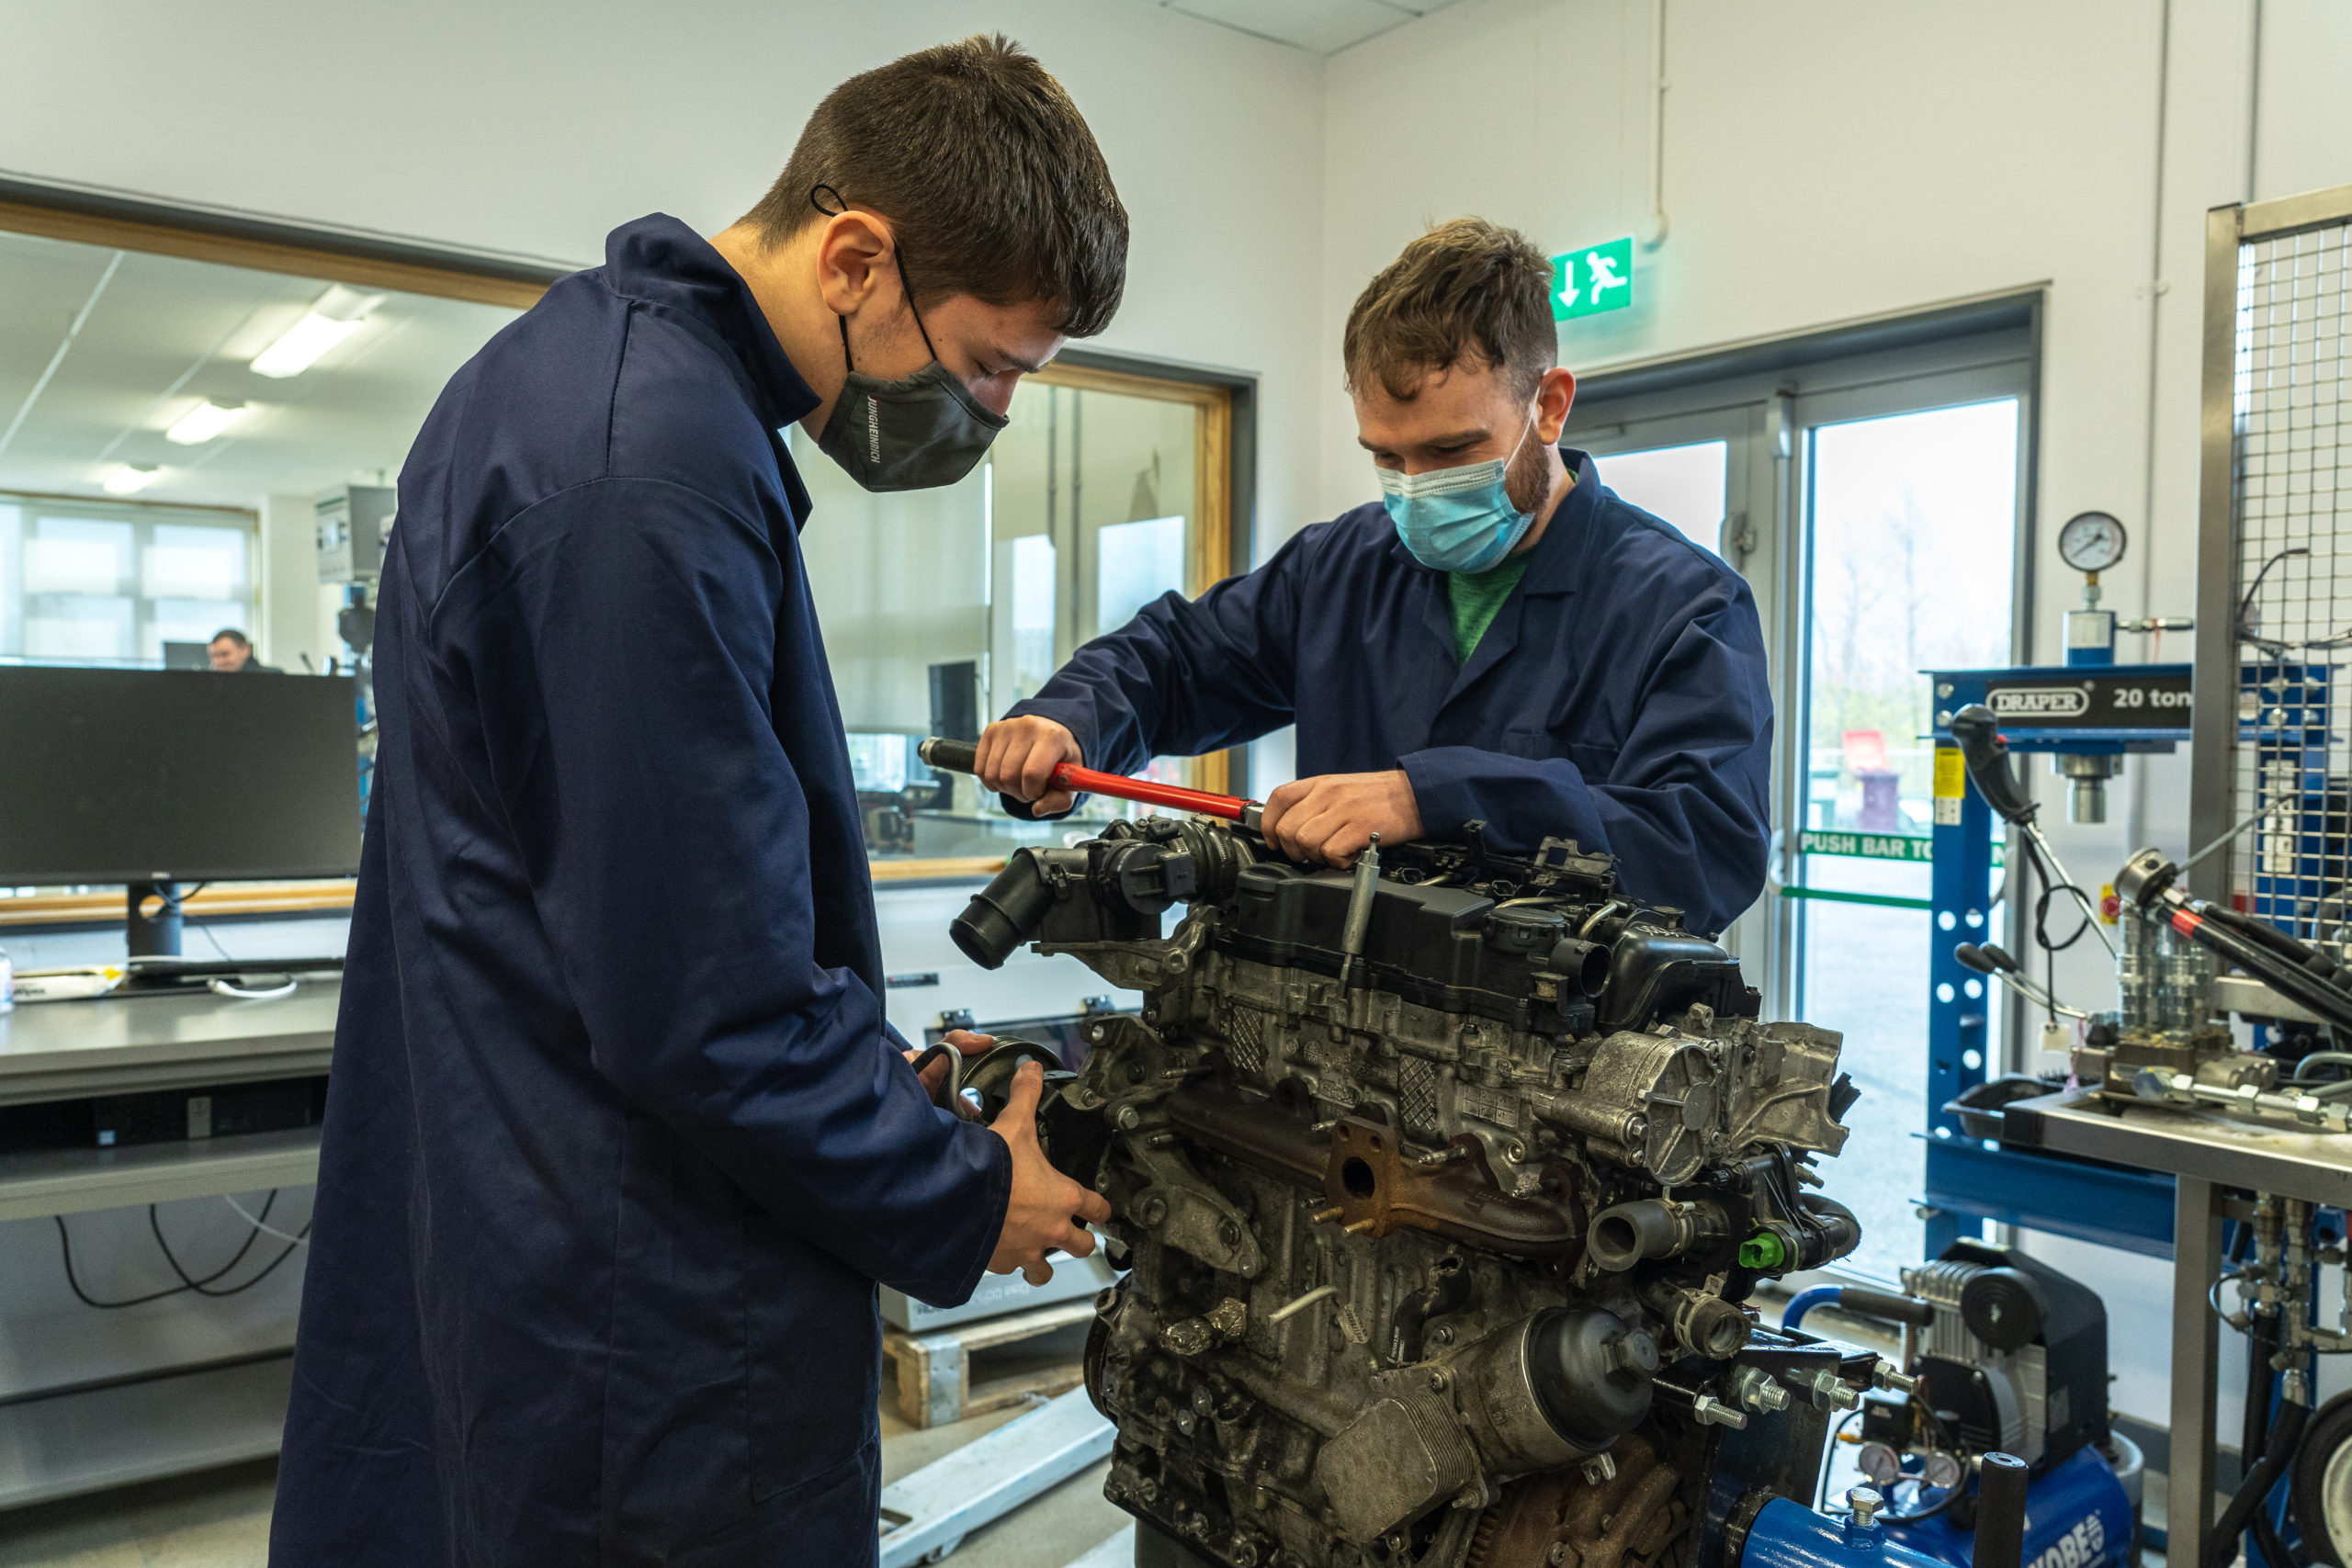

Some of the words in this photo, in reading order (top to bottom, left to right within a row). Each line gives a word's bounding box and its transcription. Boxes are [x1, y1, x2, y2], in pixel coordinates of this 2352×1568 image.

[867, 395, 880, 463] JUNGHEINRICH
[1996, 693, 2079, 712] DRAPER
[2113, 688, 2143, 707] 20
[1801, 832, 1856, 854] PUSH
[1861, 837, 1906, 858] BAR
